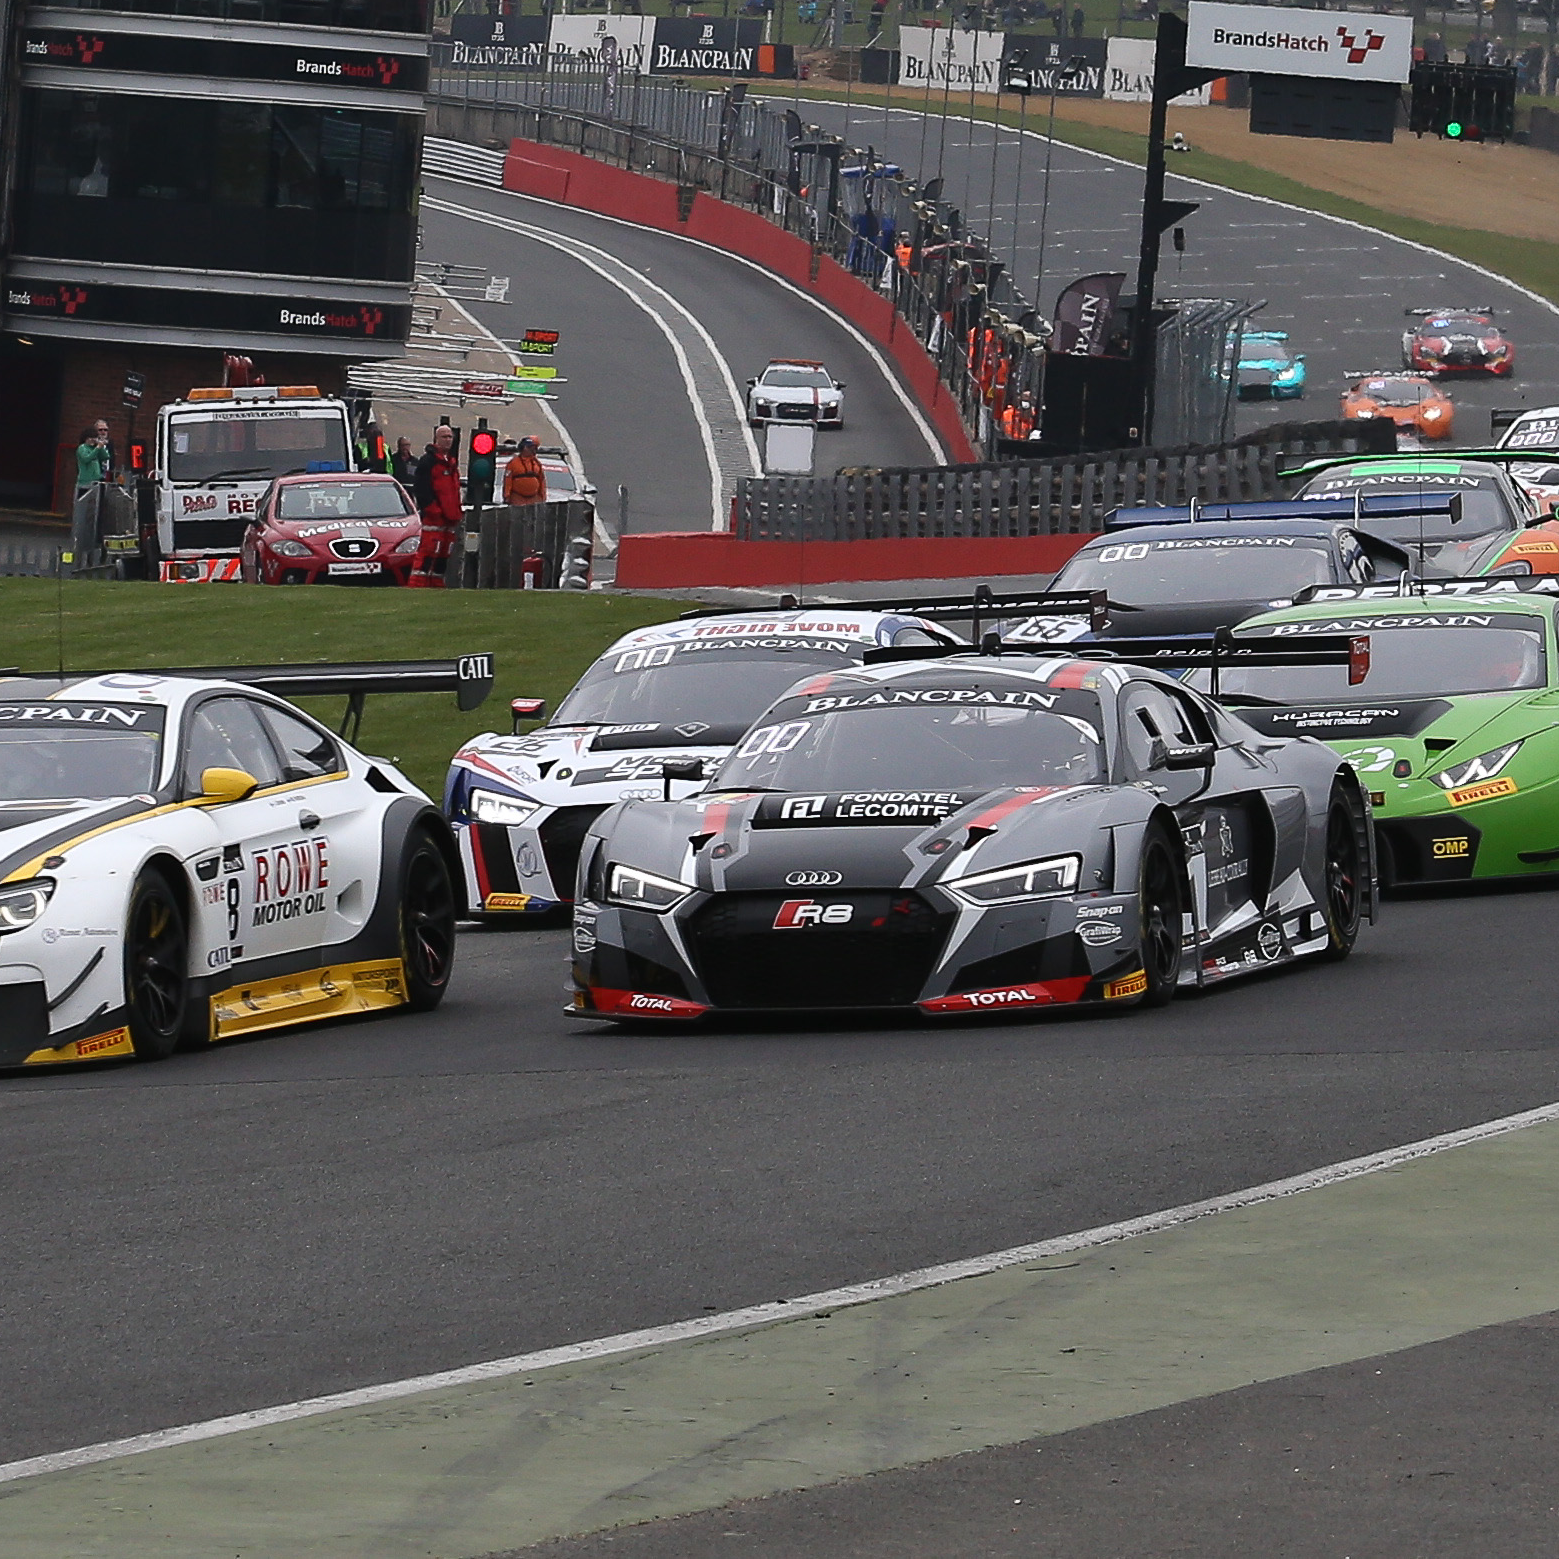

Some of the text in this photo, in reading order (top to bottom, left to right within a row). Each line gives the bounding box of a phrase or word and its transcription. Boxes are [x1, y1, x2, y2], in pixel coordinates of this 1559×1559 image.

[1213, 27, 1329, 53] BrandsHatch
[451, 41, 545, 66] BLANCPAIN
[554, 43, 646, 68] BLANCAIN
[656, 45, 754, 71] BLANCPAIN
[905, 55, 994, 84] BLANCPAIN
[1325, 475, 1482, 491] BLANCPAIN
[298, 519, 409, 538] Medical Car
[1156, 537, 1296, 550] BLANCPAIN
[1272, 614, 1495, 636] BLANCPAIN
[680, 638, 852, 654] BLANCPAIN
[458, 656, 494, 681] CATL
[801, 688, 1061, 715] BLANCPAIN
[838, 792, 964, 805] FONDATEL
[1451, 780, 1511, 803] PIRELLI
[835, 803, 950, 819] LECOMTE
[1433, 840, 1469, 855] OMP
[252, 841, 329, 903] ROWE
[251, 892, 327, 928] MOTOR OIL
[792, 900, 855, 929] R8
[1076, 904, 1124, 919] Snap-on
[206, 946, 231, 968] CATL
[629, 994, 673, 1012] TOTAL
[963, 989, 1037, 1007] TOTAL
[76, 1028, 125, 1057] PIRELLI
